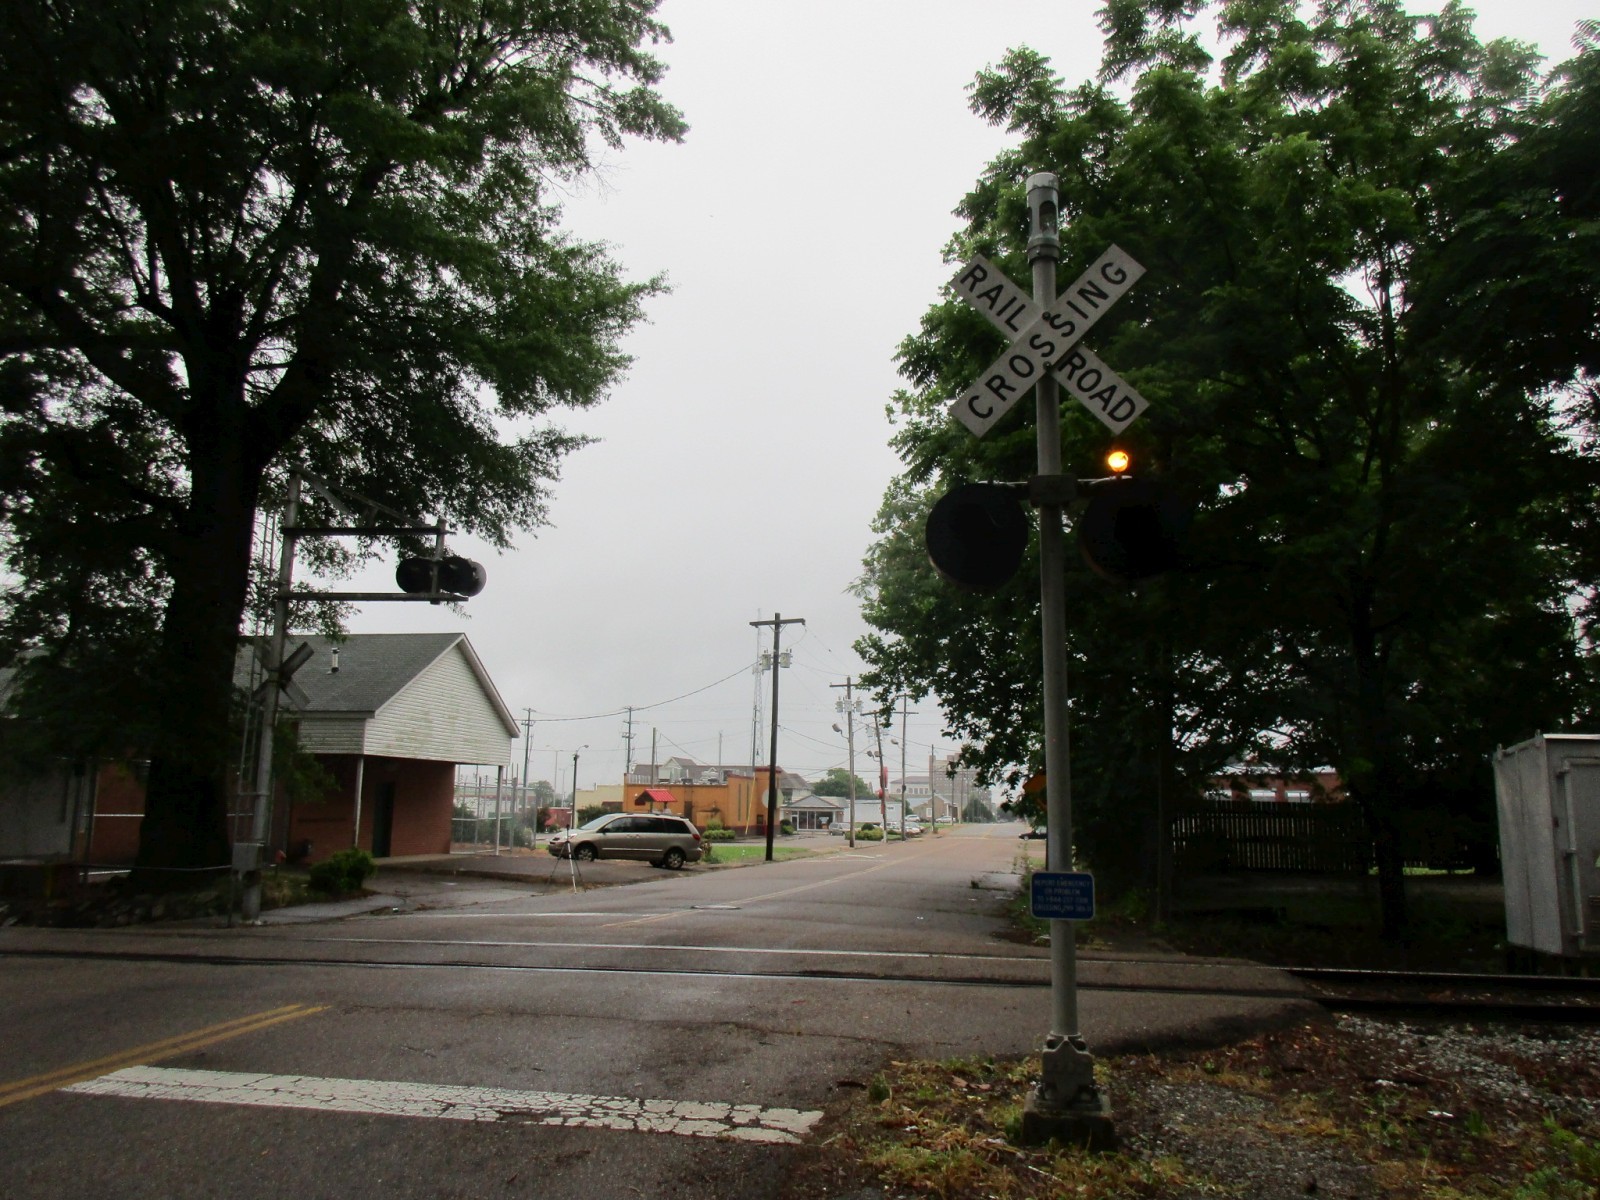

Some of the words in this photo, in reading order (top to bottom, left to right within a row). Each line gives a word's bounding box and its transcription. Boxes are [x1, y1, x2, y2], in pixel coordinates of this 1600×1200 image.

[960, 263, 1026, 333] RAIL
[1058, 351, 1136, 423] ROAD
[967, 262, 1127, 419] CROSSING
